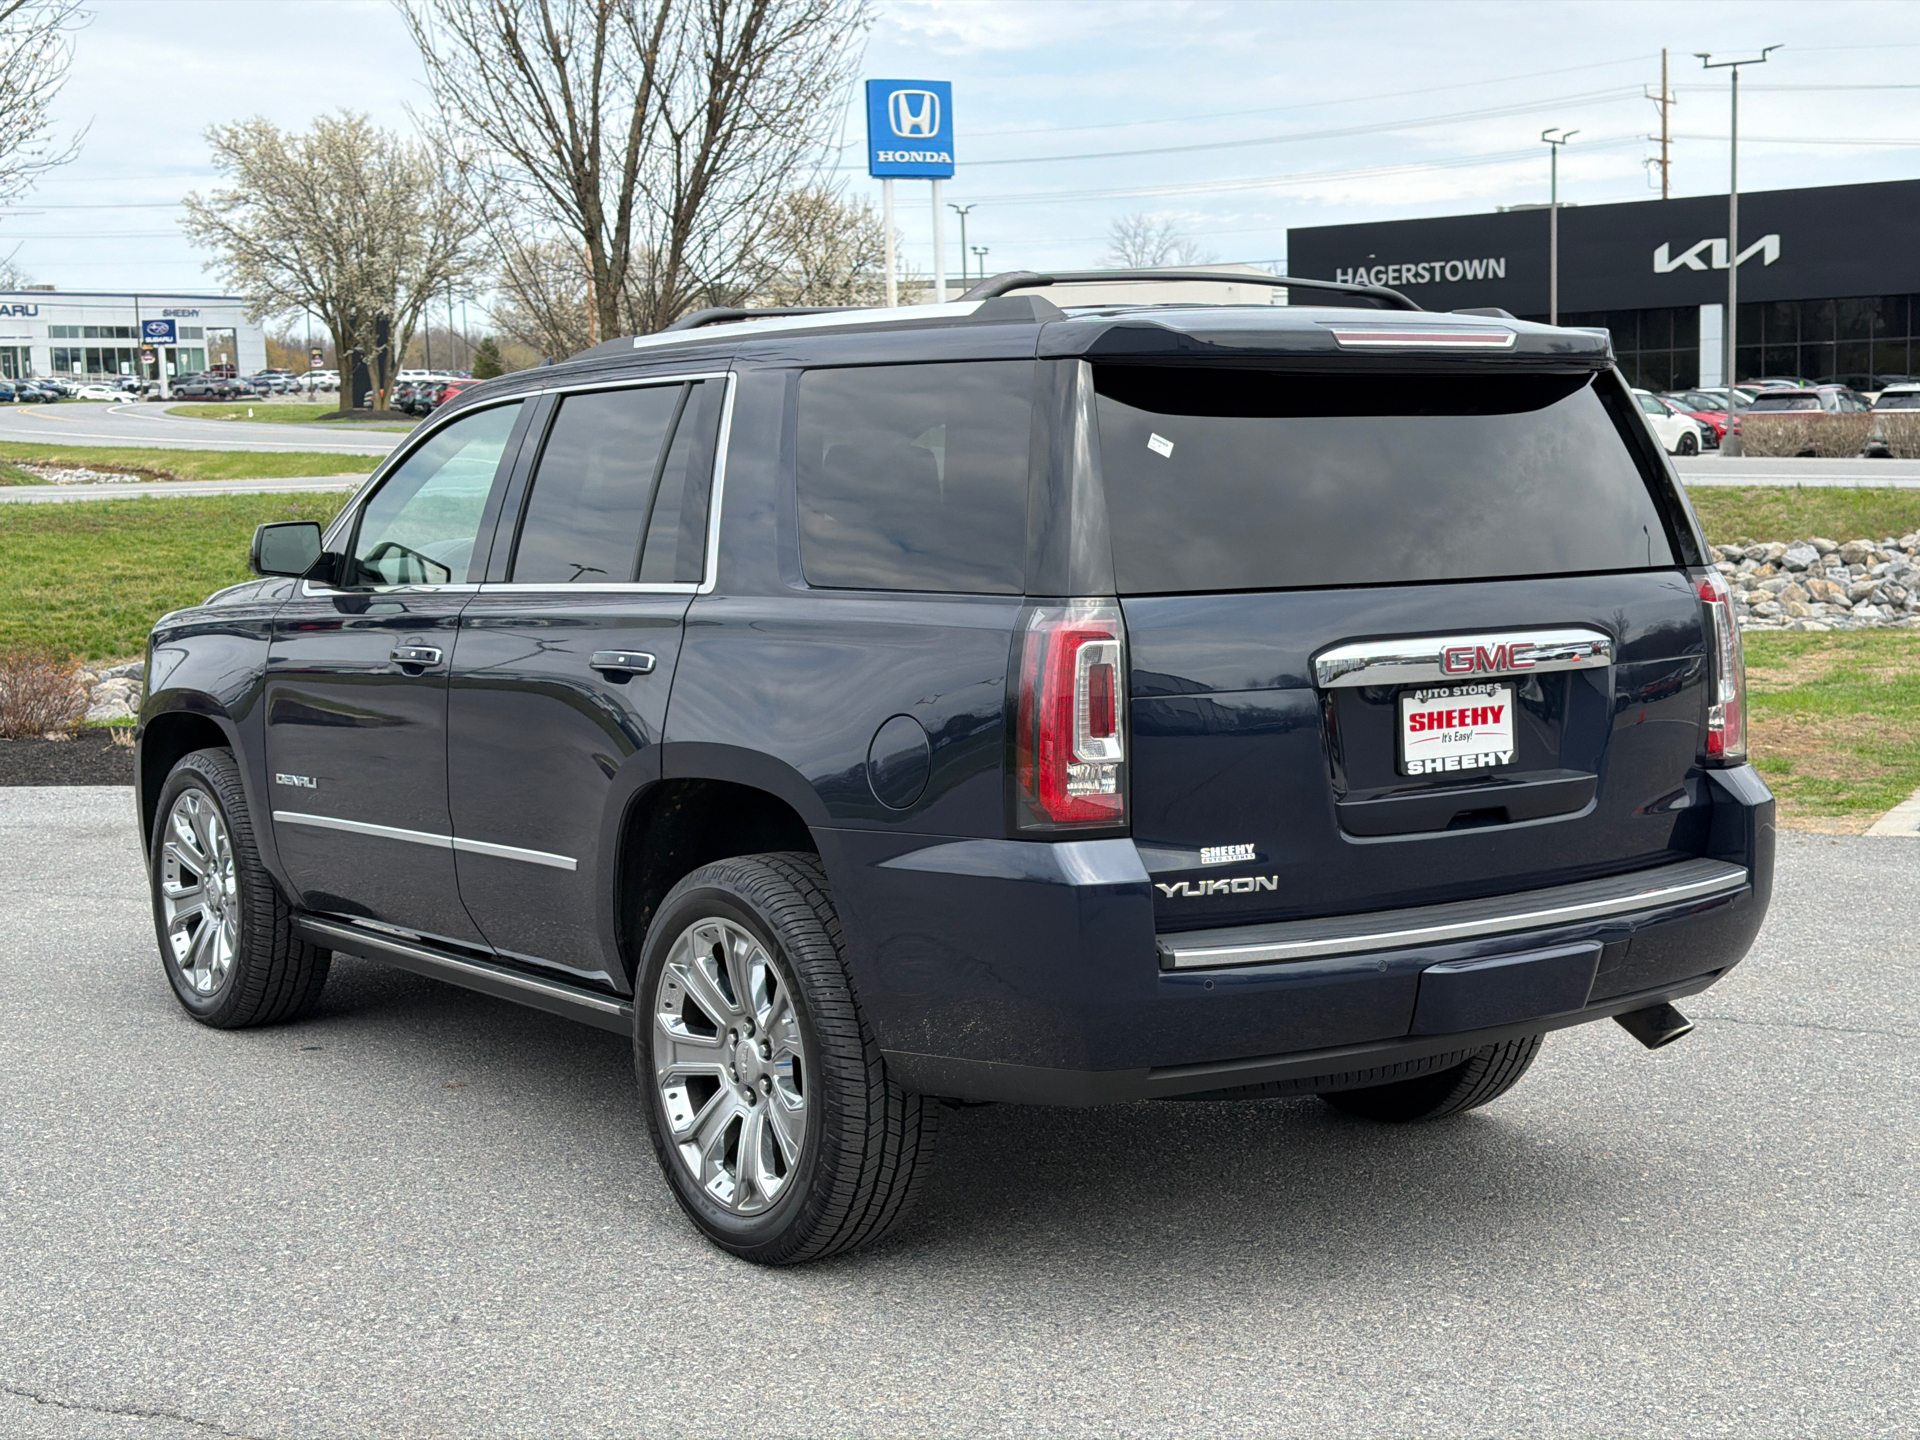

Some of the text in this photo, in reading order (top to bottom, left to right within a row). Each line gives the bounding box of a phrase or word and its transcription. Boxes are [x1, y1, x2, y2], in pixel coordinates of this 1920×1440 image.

[877, 151, 952, 163] HONDA
[1654, 234, 1781, 273] KIA
[1336, 257, 1506, 286] HAGERSTOWN
[162, 309, 200, 318] SHEEHY
[1441, 642, 1536, 674] GMC
[1414, 683, 1502, 700] AUTO STORES
[1409, 705, 1505, 732] SHEEHY
[1441, 729, 1473, 743] It's Easy!
[1407, 750, 1514, 775] SHEEHY
[275, 773, 317, 788] DENALI
[1200, 843, 1255, 858] SHEEHY
[1154, 875, 1278, 898] YUKON
